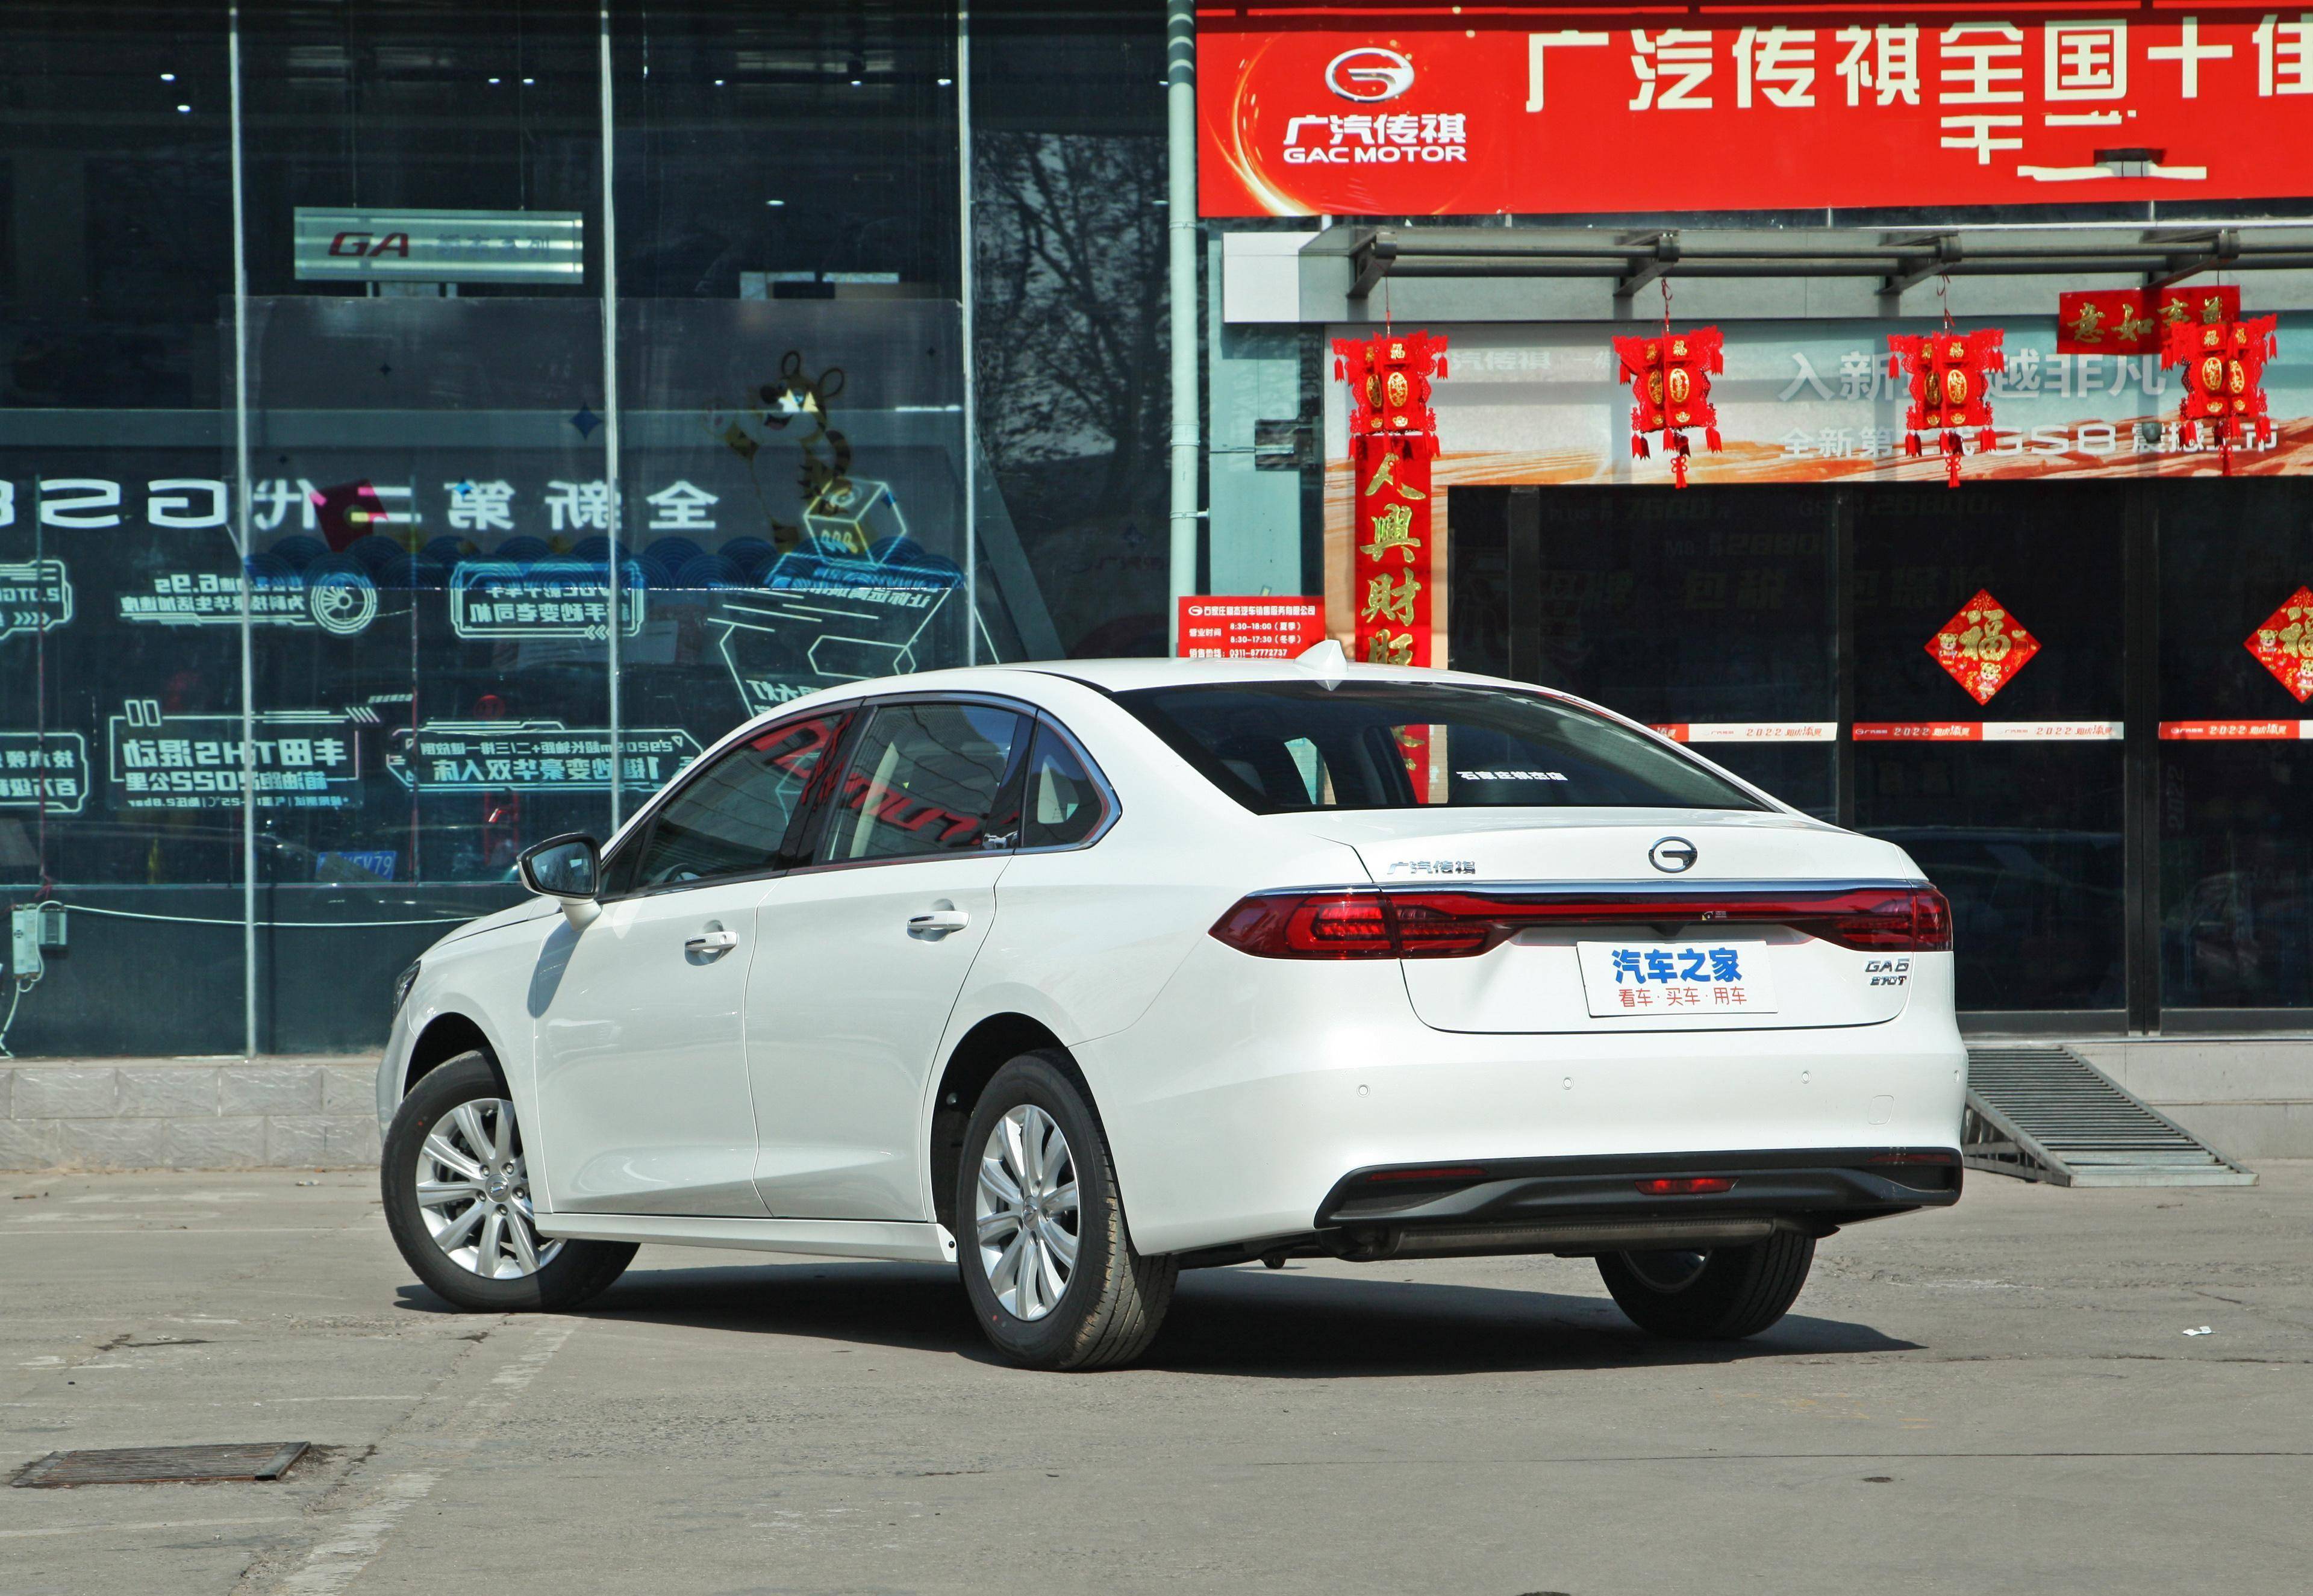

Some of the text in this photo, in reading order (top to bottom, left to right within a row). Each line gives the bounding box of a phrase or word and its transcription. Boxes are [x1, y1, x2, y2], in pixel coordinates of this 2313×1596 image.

[1283, 114, 1467, 145] 广汽传祺
[1283, 145, 1467, 163] GAC MOTOR
[328, 231, 409, 257] GA
[1449, 351, 1552, 371] 汽传祺
[1189, 628, 1222, 637] 营业时间
[1959, 609, 2012, 661] 福
[1746, 728, 1782, 737] 2022
[1894, 727, 1930, 736] 2022
[2036, 726, 2073, 735] 2022
[1387, 860, 1476, 875] 广汽传祺
[1612, 947, 1743, 985] 汽车之家
